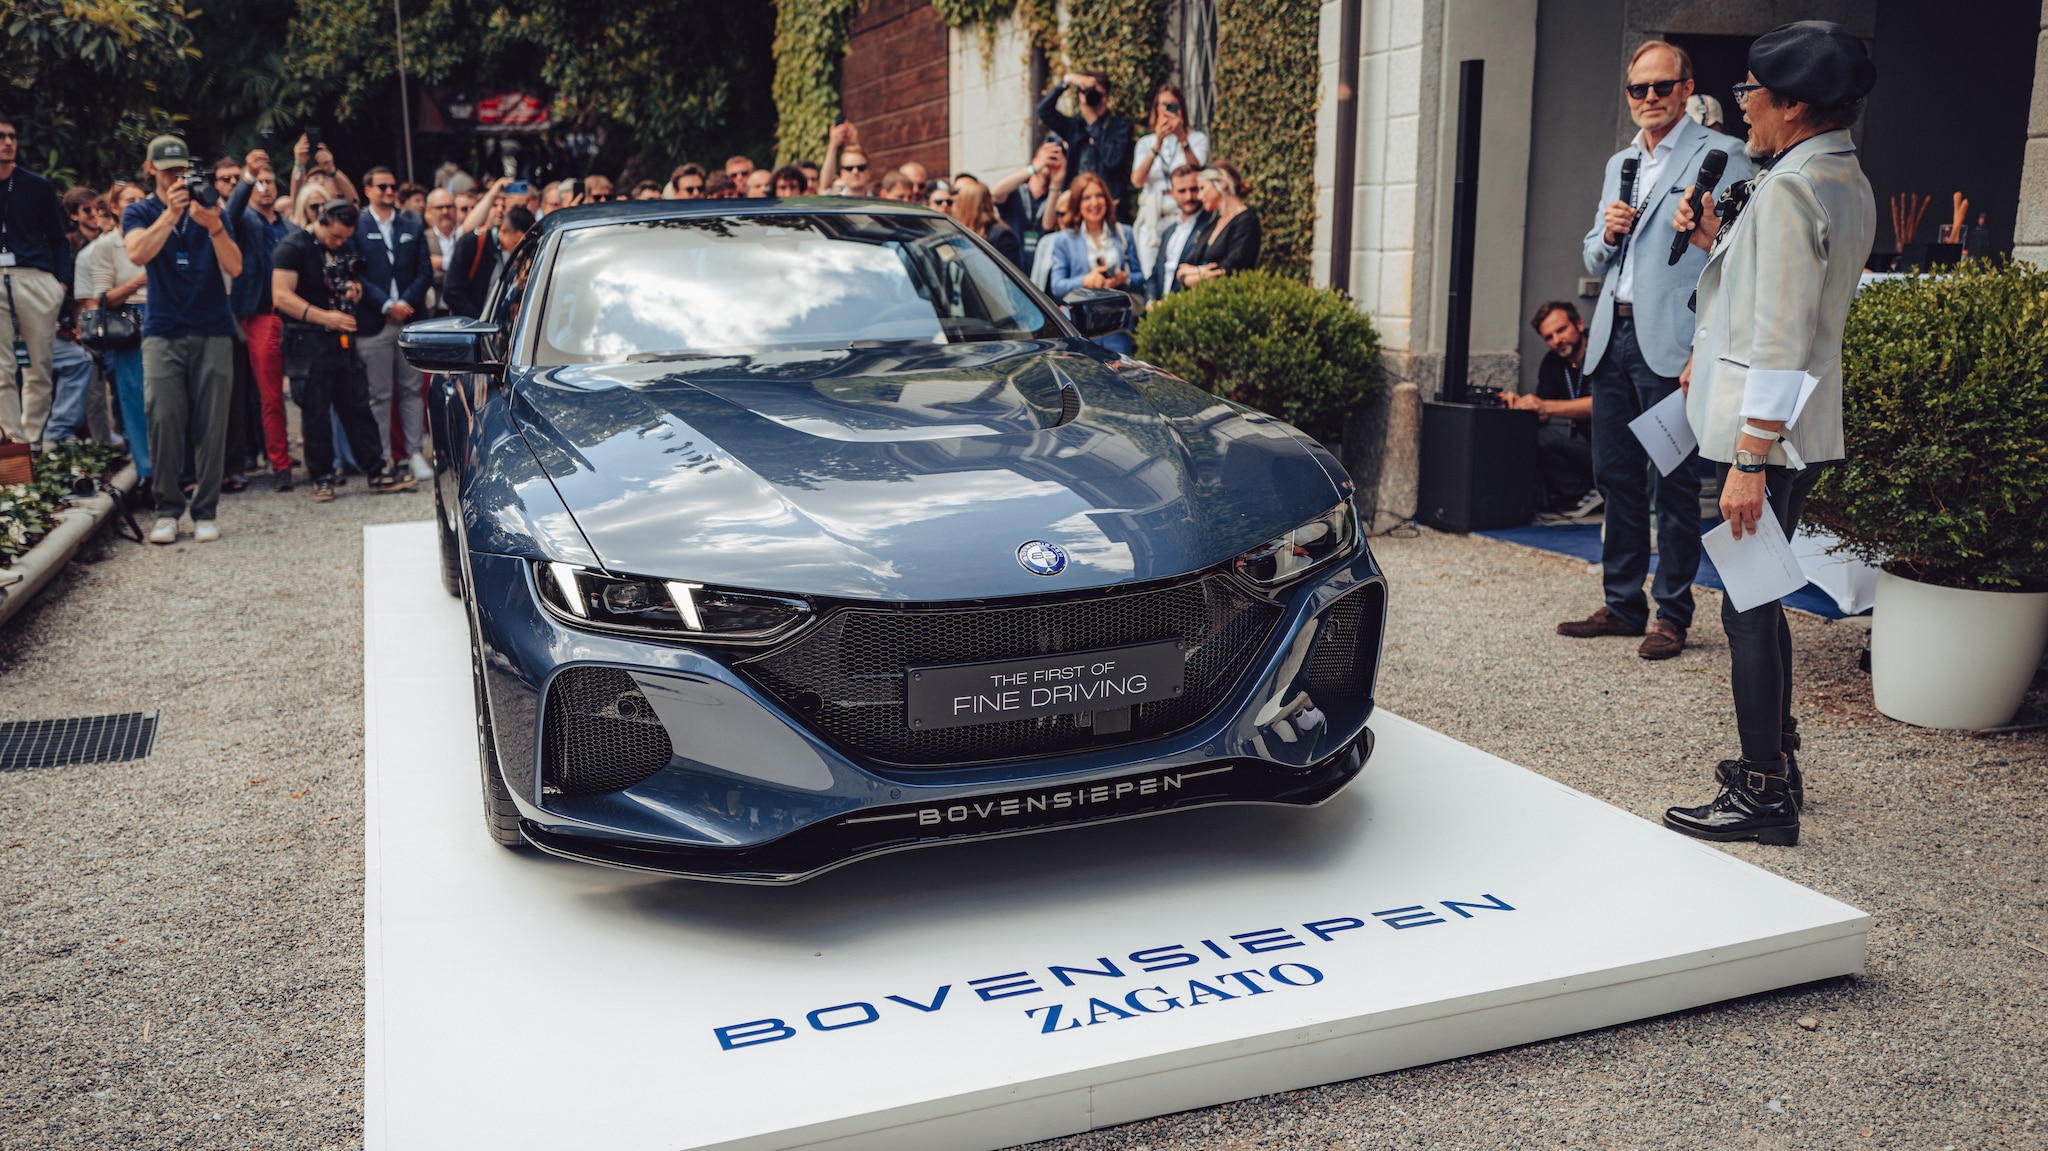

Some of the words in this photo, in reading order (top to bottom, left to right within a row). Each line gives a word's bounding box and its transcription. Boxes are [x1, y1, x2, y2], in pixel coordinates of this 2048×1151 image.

[953, 690, 1020, 716] FINE
[1031, 674, 1147, 708] DRIVING
[991, 673, 1028, 687] THE
[1034, 665, 1085, 683] FIRST
[1091, 661, 1116, 676] OF
[919, 773, 1182, 826] BOVENSIEPEN
[714, 893, 1517, 1050] BOVENSIEPEN
[1025, 962, 1324, 1035] ZAGATO
